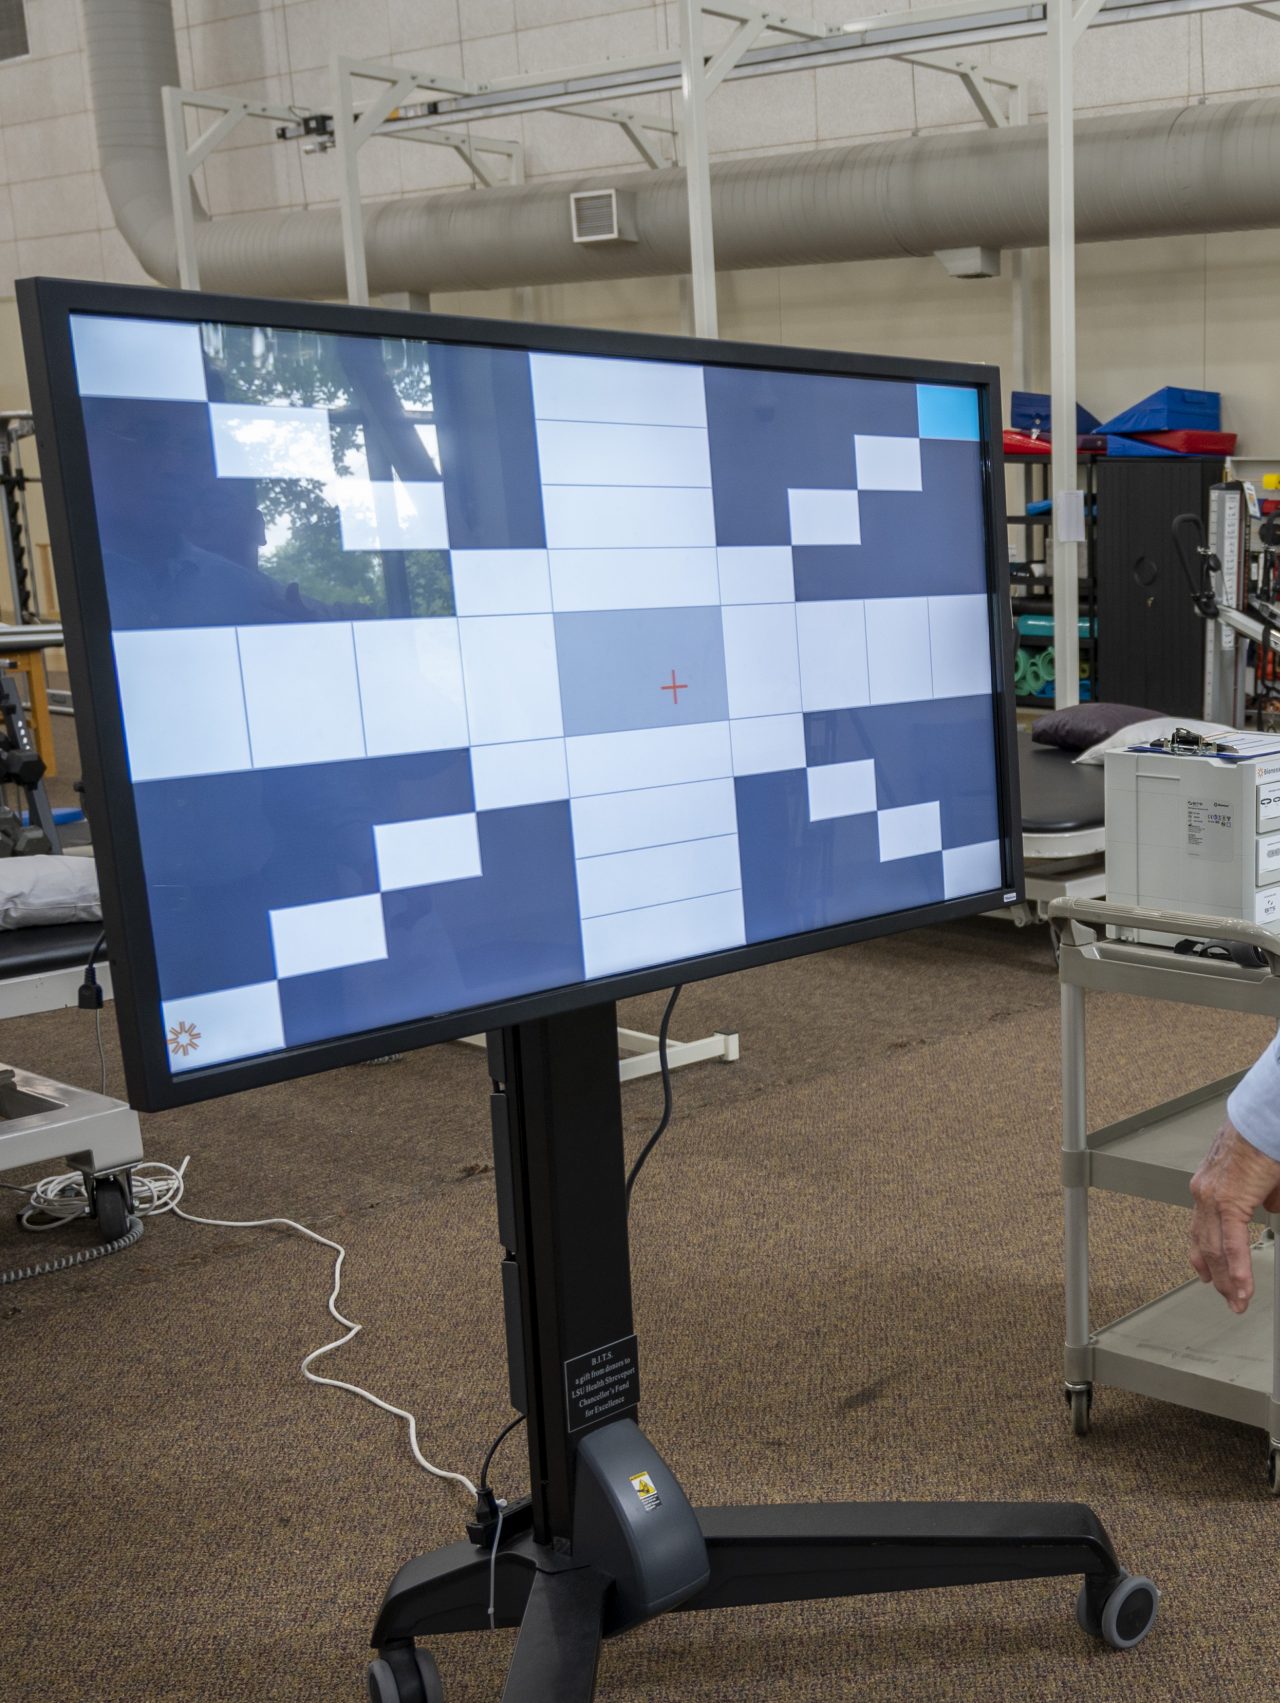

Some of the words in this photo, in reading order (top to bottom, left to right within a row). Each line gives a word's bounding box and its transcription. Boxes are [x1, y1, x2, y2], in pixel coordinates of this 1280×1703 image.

[591, 1351, 613, 1365] B.I.T.S.
[571, 1386, 585, 1399] LSU
[585, 1379, 605, 1393] Health
[604, 1367, 636, 1385] Shreveport
[580, 1372, 591, 1385] gift
[591, 1368, 605, 1379] from
[605, 1361, 624, 1372] donors
[615, 1380, 630, 1393] Fund
[585, 1409, 594, 1418] for
[594, 1396, 625, 1413] Excellence
